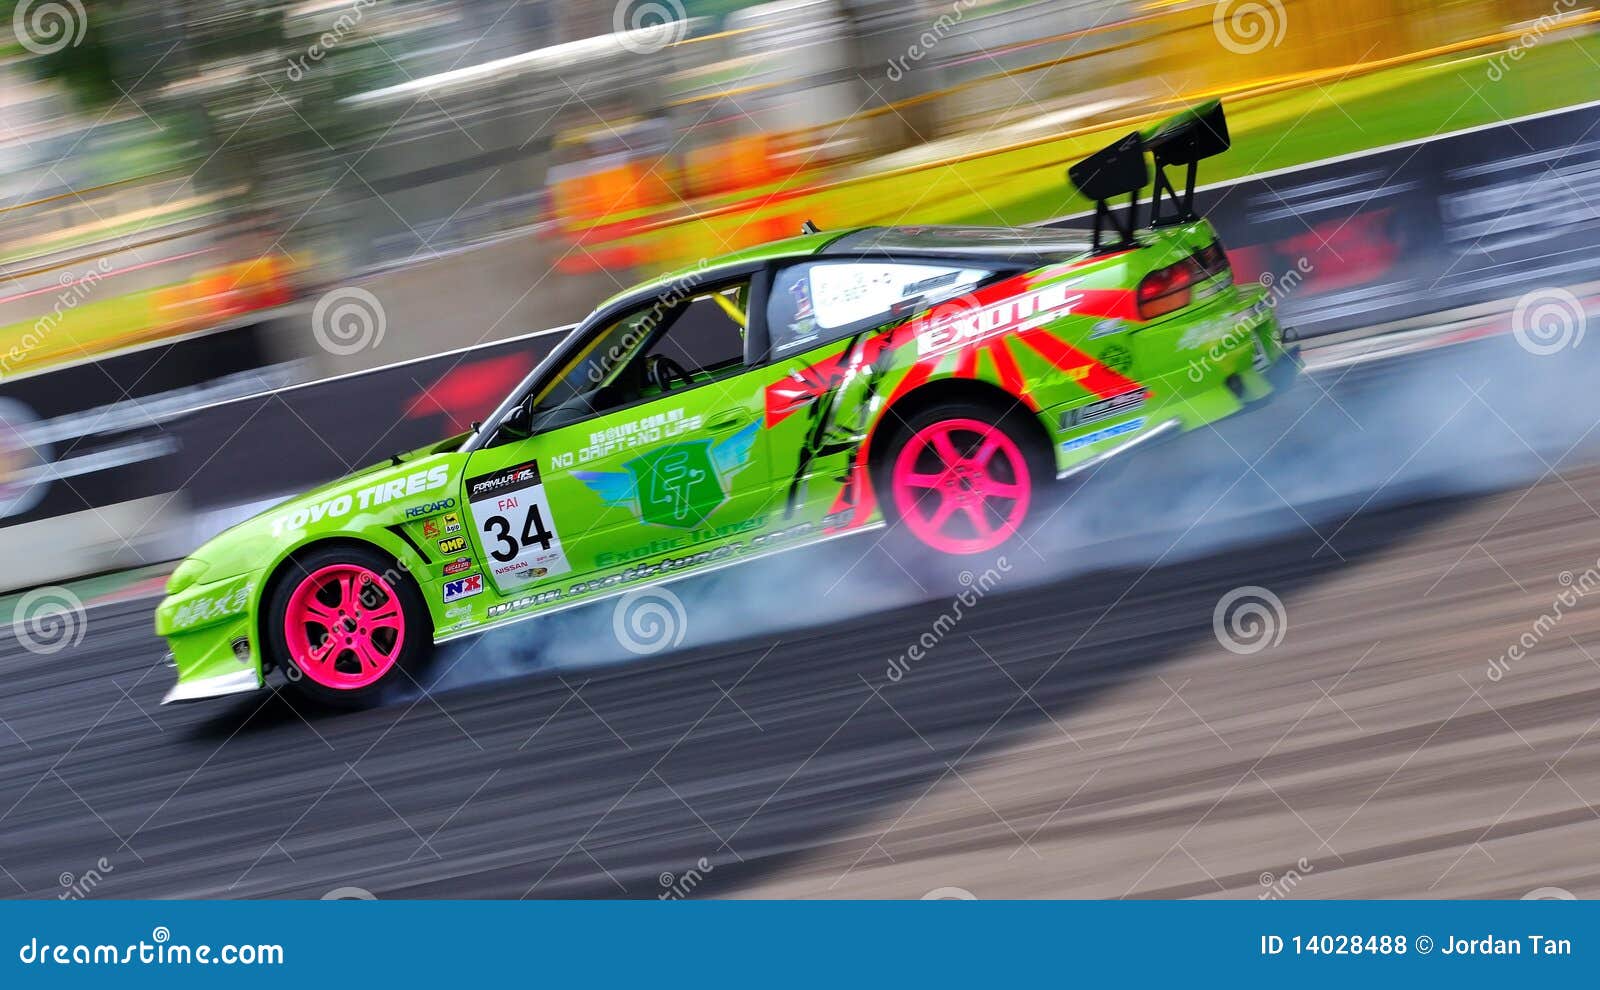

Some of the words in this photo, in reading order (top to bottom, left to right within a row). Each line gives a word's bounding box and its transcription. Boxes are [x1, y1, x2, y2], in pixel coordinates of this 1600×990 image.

[551, 451, 574, 470] NO
[270, 493, 353, 538] TOYO
[356, 463, 450, 505] TIRES
[405, 497, 456, 519] RECARO
[498, 496, 519, 511] FAI
[483, 503, 553, 562] 34
[440, 537, 465, 553] OMP
[495, 560, 528, 575] NISSAN
[445, 575, 481, 597] NX
